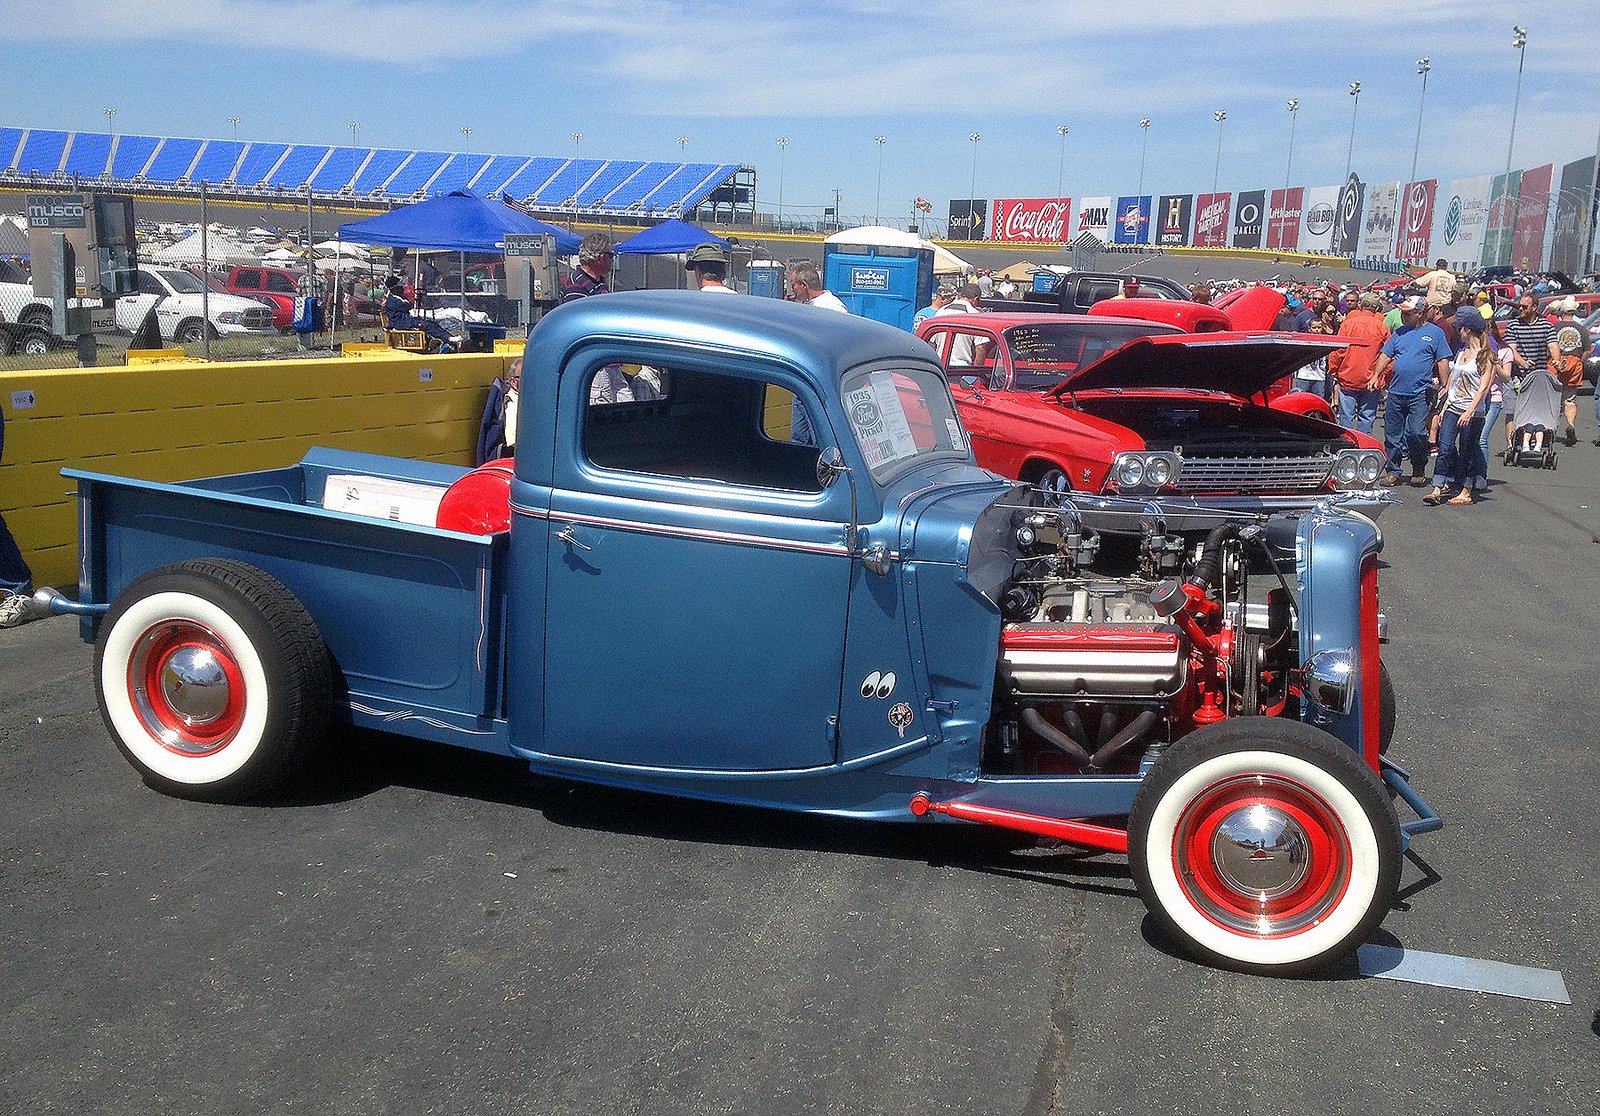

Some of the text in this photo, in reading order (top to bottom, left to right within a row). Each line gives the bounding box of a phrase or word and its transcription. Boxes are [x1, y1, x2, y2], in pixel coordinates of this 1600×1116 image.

[950, 214, 971, 229] Sprint
[1234, 225, 1262, 235] OAKLEY
[1160, 233, 1182, 242] HISTORY
[1397, 237, 1426, 256] TYOTA
[848, 390, 871, 404] 1935
